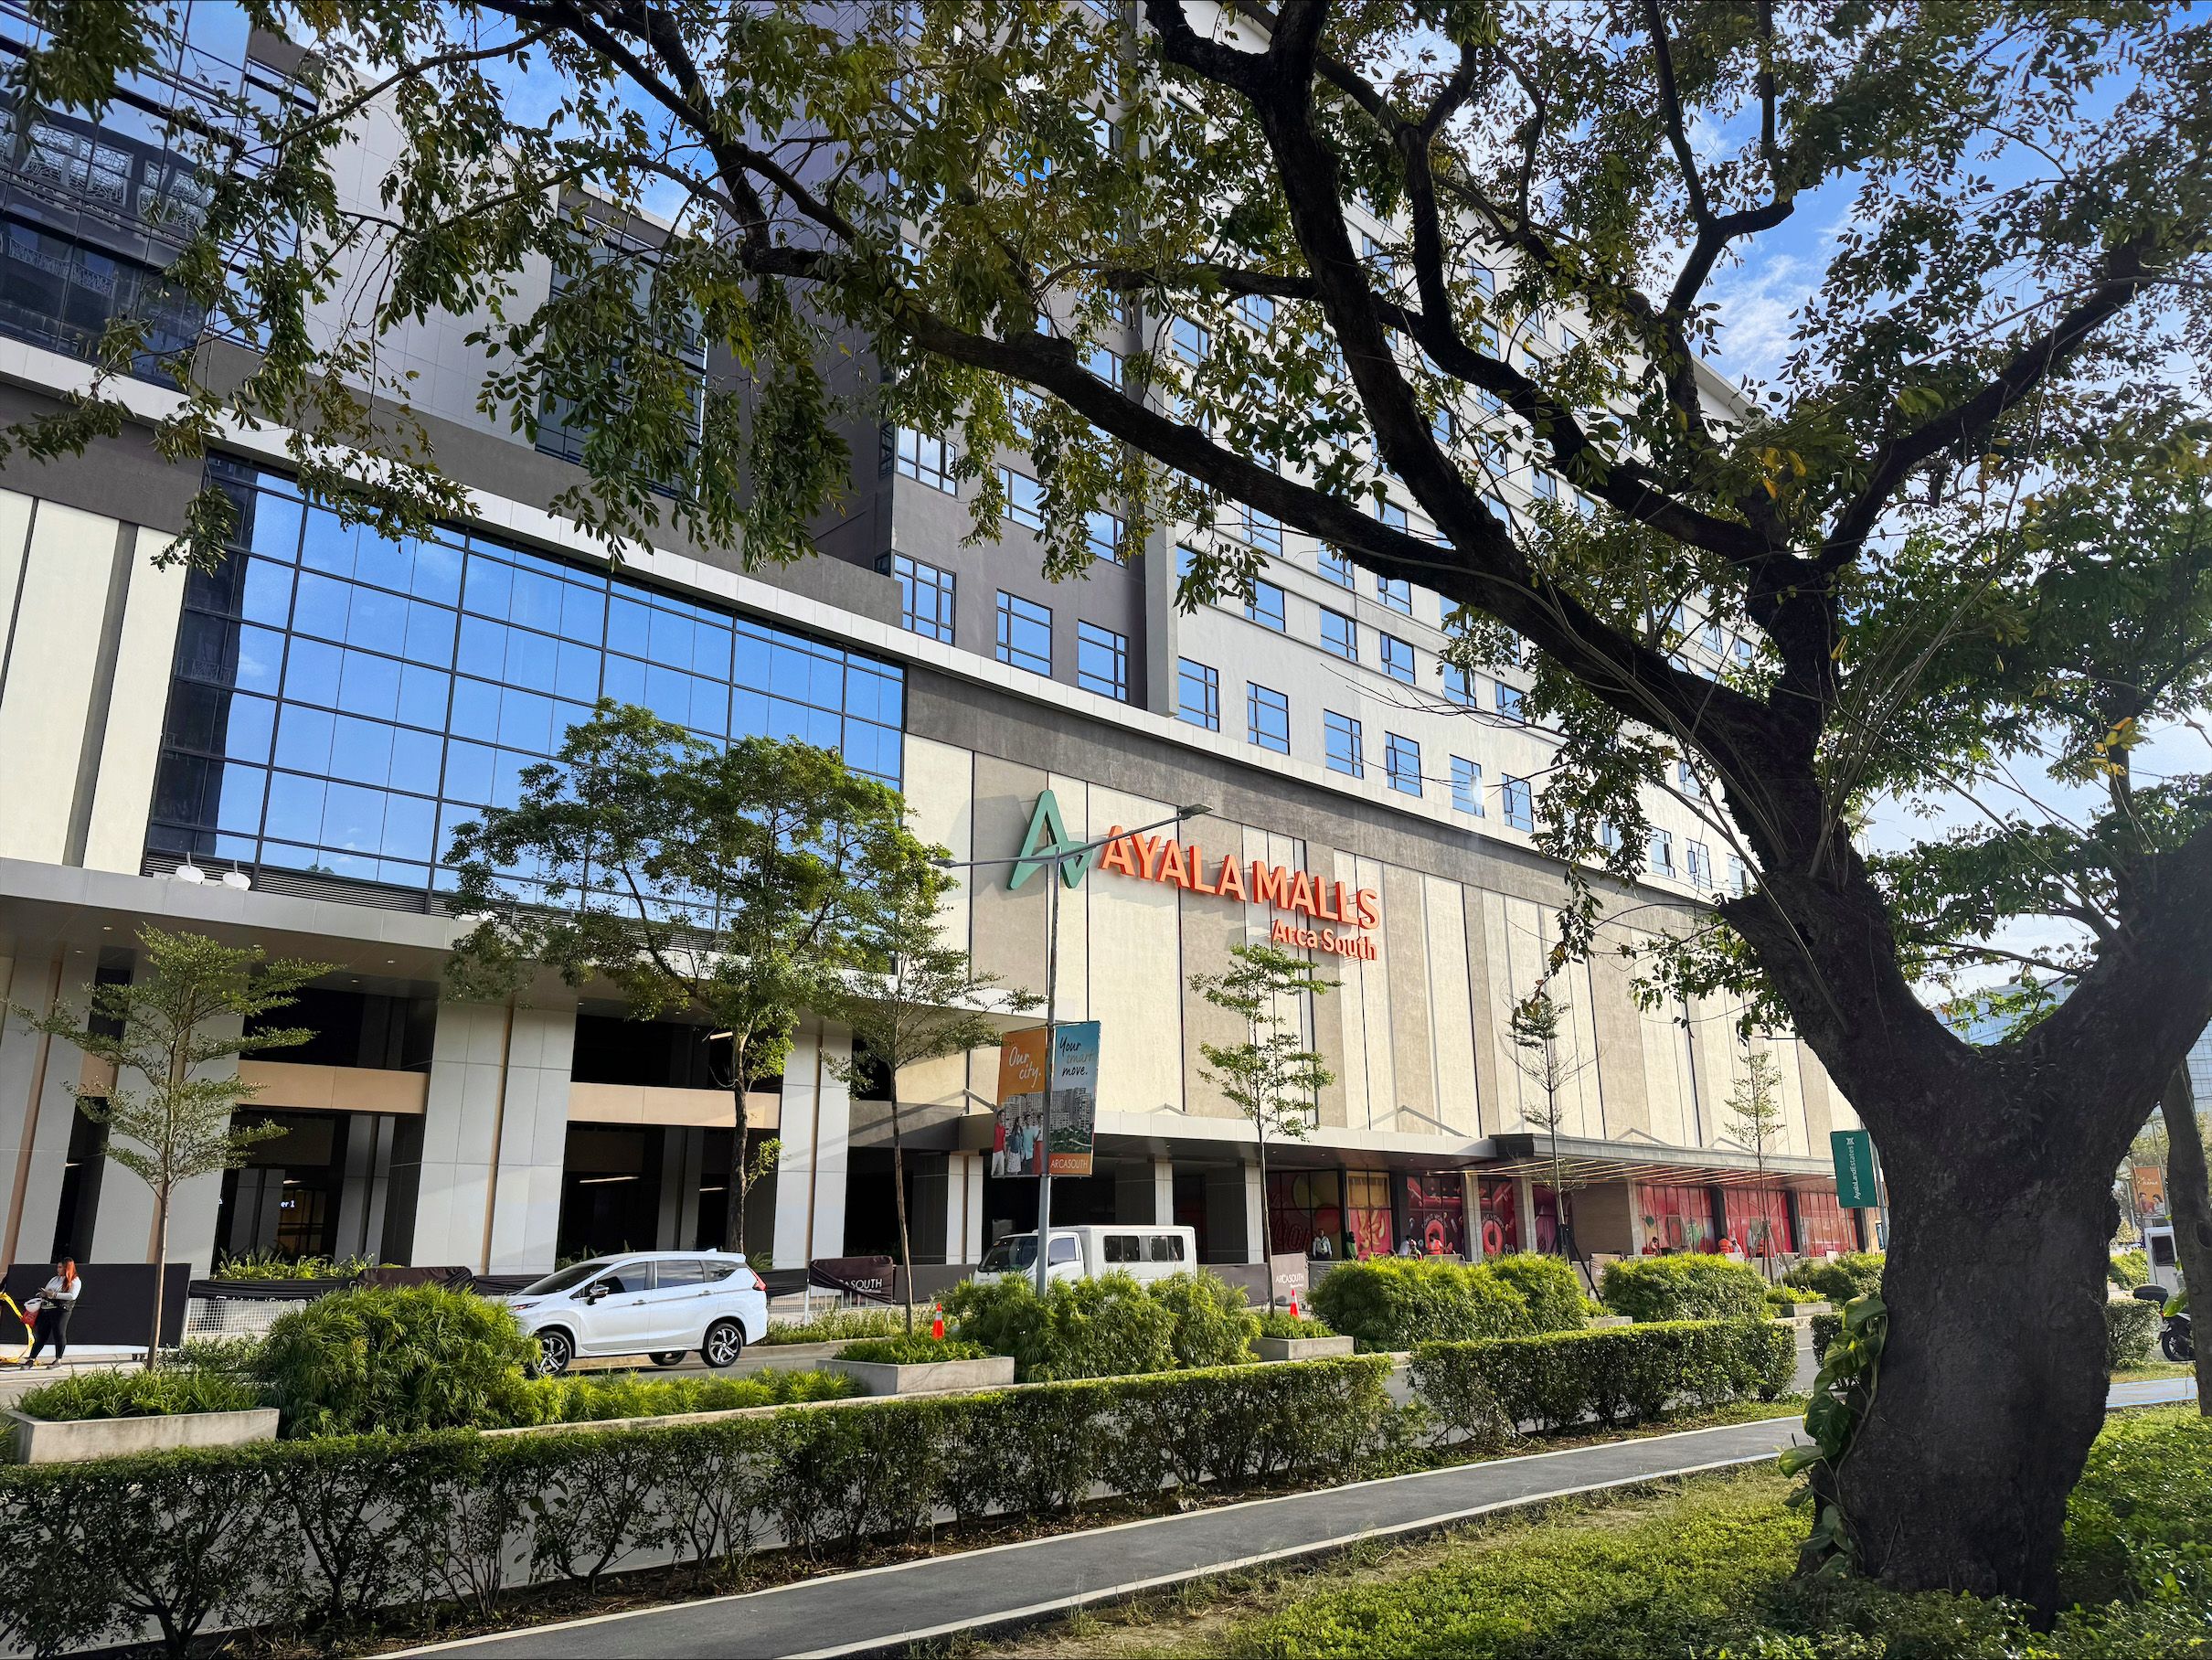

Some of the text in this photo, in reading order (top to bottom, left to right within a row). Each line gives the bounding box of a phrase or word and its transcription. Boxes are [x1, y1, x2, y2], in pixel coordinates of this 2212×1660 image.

[1099, 825, 1380, 931] AYALA MALLS
[1272, 919, 1377, 961] Arca South
[1009, 1046, 1030, 1067] Our
[1059, 1036, 1081, 1057] Your
[1061, 1066, 1088, 1077] move.
[1050, 1158, 1089, 1169] ARCASOUTH
[1848, 1145, 1861, 1200] AyalaLandEstates
